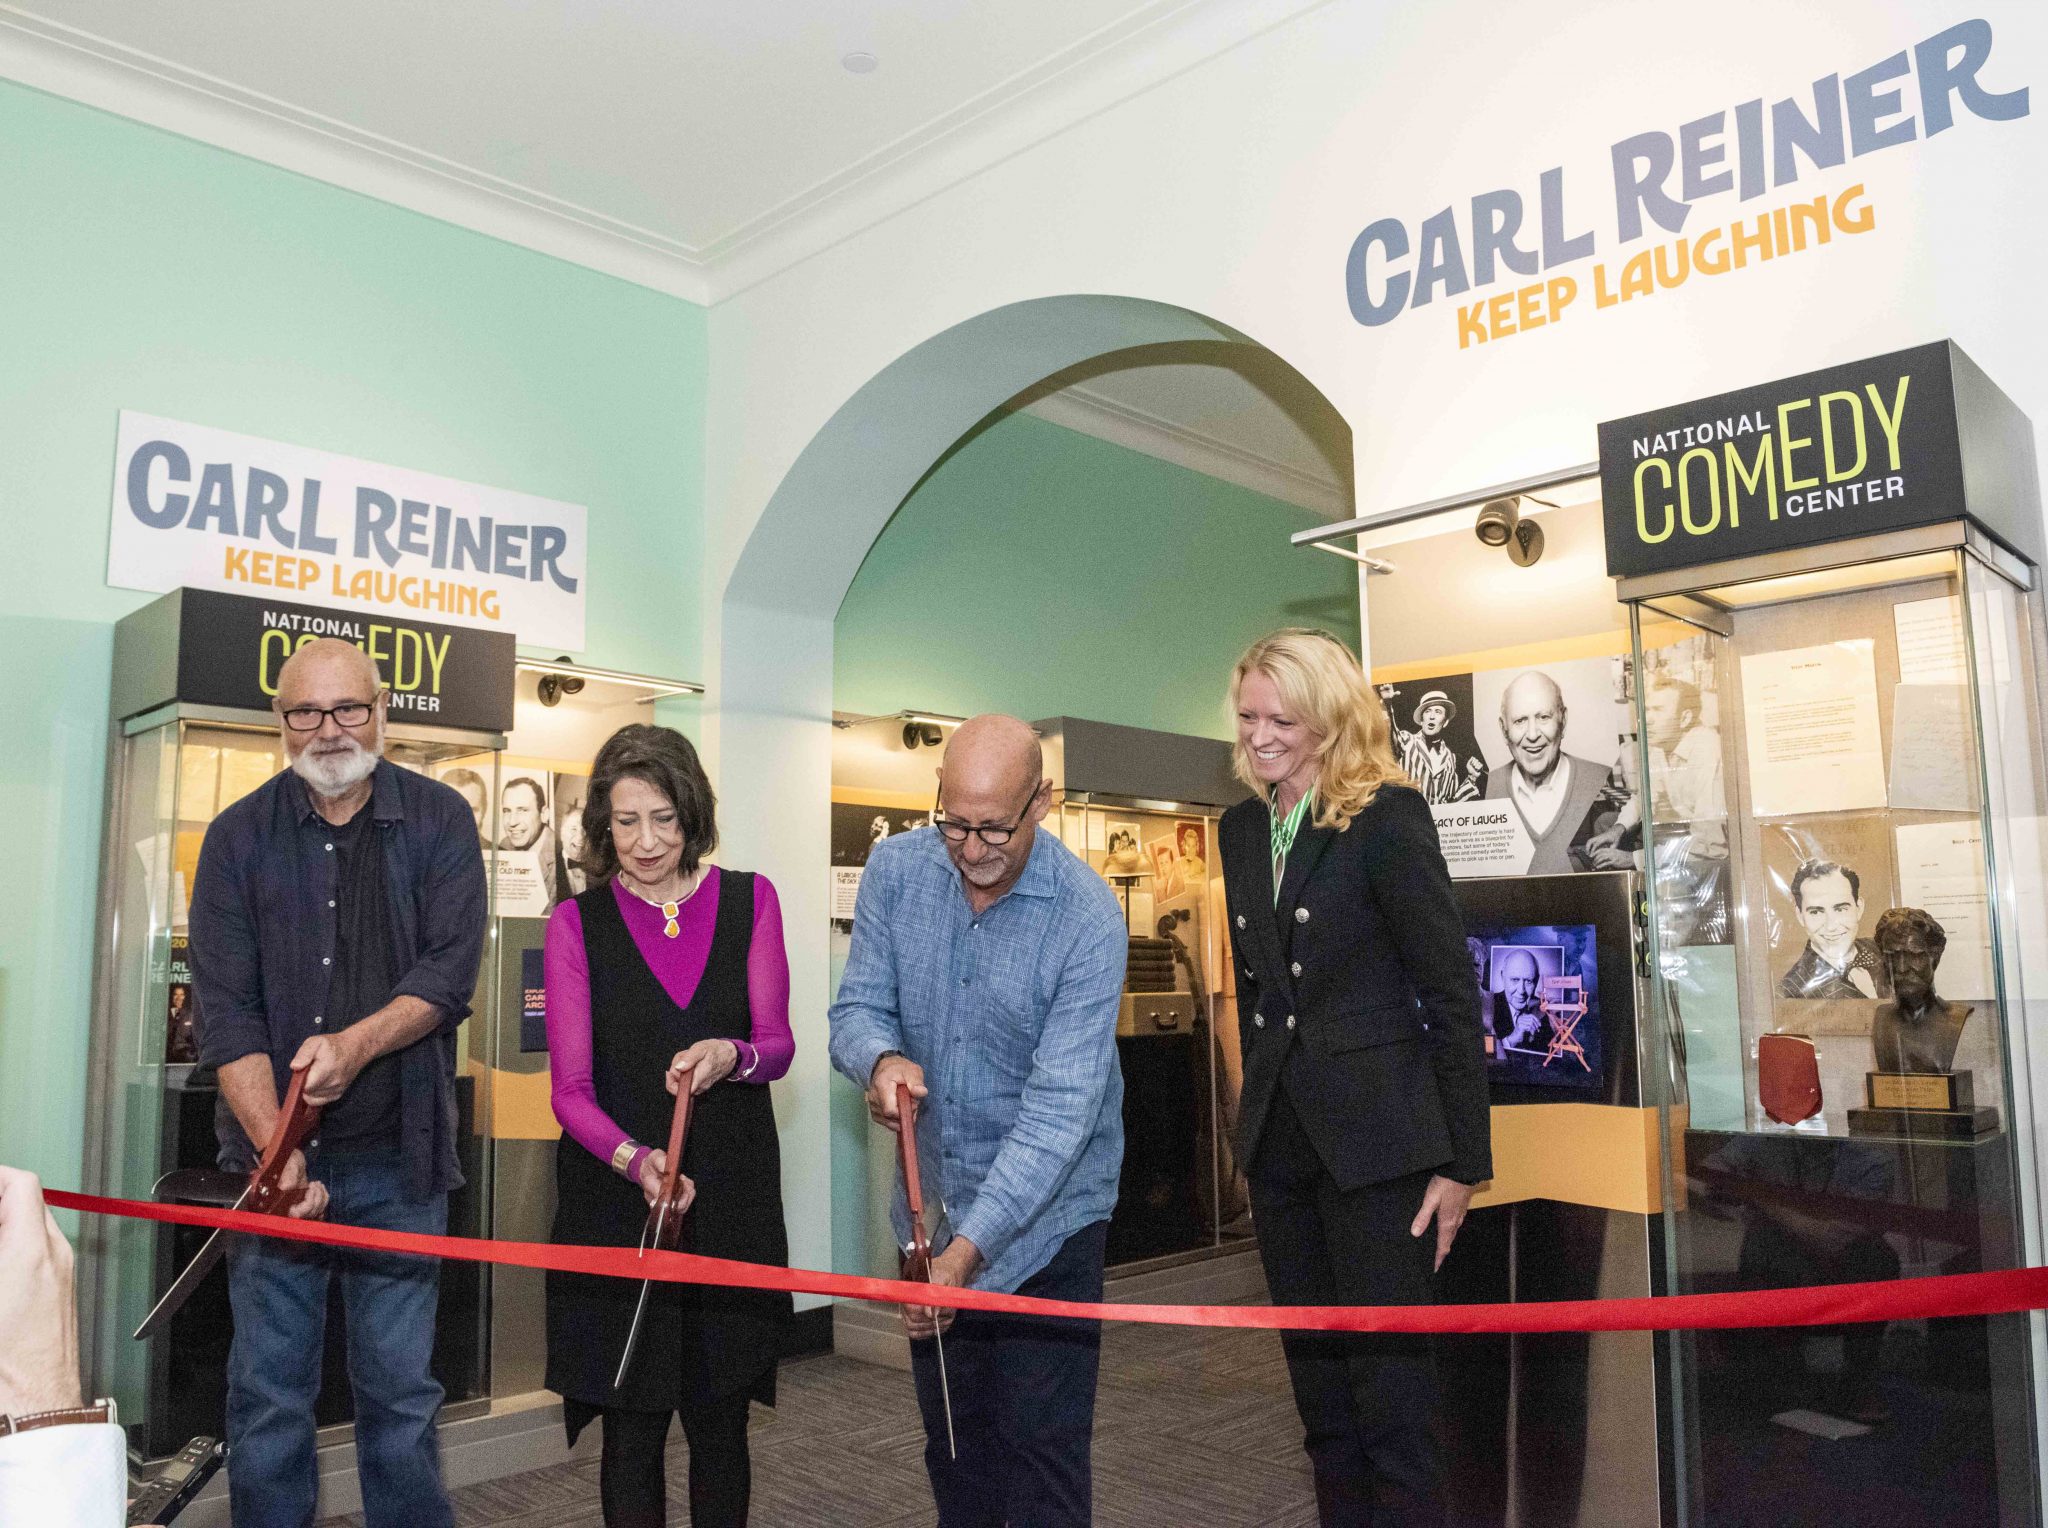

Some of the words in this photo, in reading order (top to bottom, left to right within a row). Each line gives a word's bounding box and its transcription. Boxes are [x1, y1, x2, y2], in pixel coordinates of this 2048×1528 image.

[1345, 166, 1595, 327] CARL
[1611, 18, 2030, 244] REINER
[1457, 276, 1578, 350] KEEP
[1593, 183, 1876, 310] LAUGHING
[1632, 411, 1771, 459] NATIONAL
[1633, 375, 1910, 544] COMEDY
[126, 440, 337, 555] CARL
[353, 486, 578, 594] REINER
[1786, 476, 1904, 517] CENTER
[223, 546, 320, 591] KEEP
[332, 564, 501, 620] LAUGHING
[259, 624, 451, 696] CEDY
[263, 611, 365, 639] NATIONAL
[1456, 816, 1470, 826] OF
[1472, 814, 1508, 825] LAUGHS
[152, 973, 192, 983] REINE
